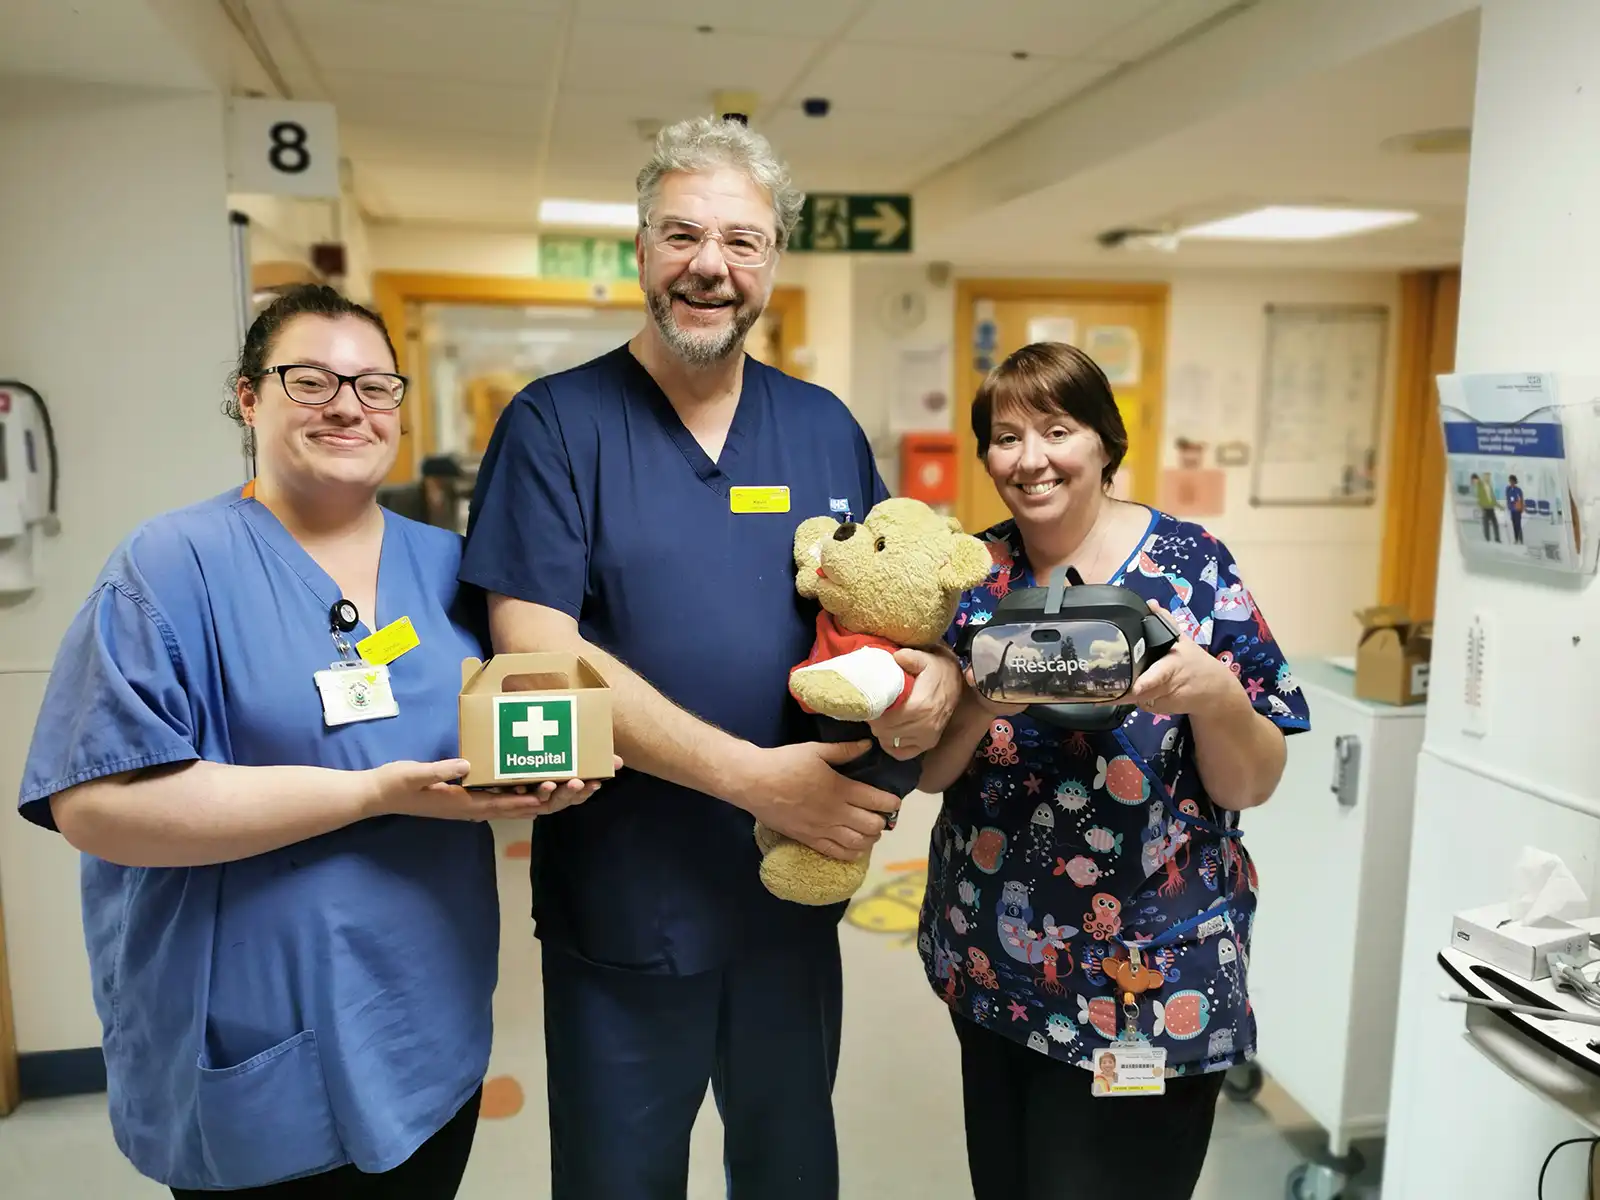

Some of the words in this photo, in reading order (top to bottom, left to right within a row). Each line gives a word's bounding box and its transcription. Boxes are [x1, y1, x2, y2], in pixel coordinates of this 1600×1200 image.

[268, 121, 311, 174] 8
[1010, 657, 1090, 676] Rescape
[506, 752, 566, 767] Hospital
